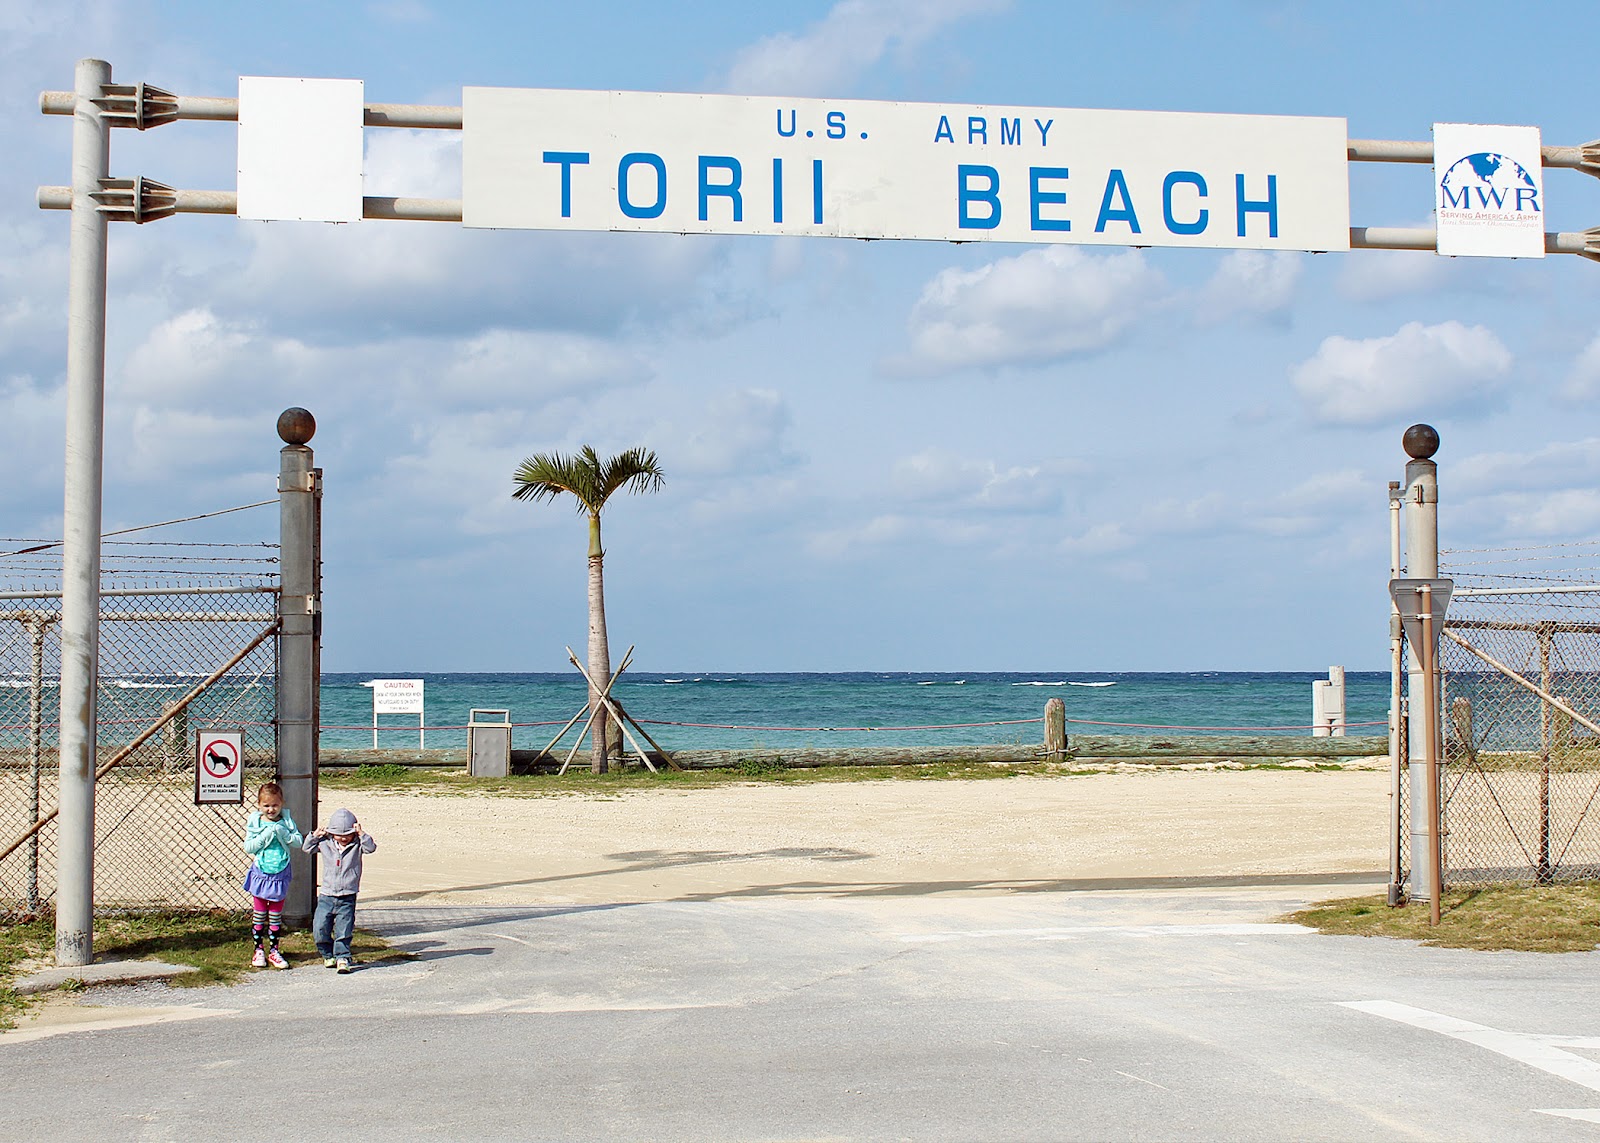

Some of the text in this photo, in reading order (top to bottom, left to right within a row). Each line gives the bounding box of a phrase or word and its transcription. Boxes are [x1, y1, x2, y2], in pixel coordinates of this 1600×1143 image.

[777, 109, 1054, 147] U.S. ARMY
[543, 151, 1278, 238] TORII BEACH
[1440, 186, 1541, 212] MWR
[1440, 210, 1539, 222] SERVING AMERICA'S ARMY
